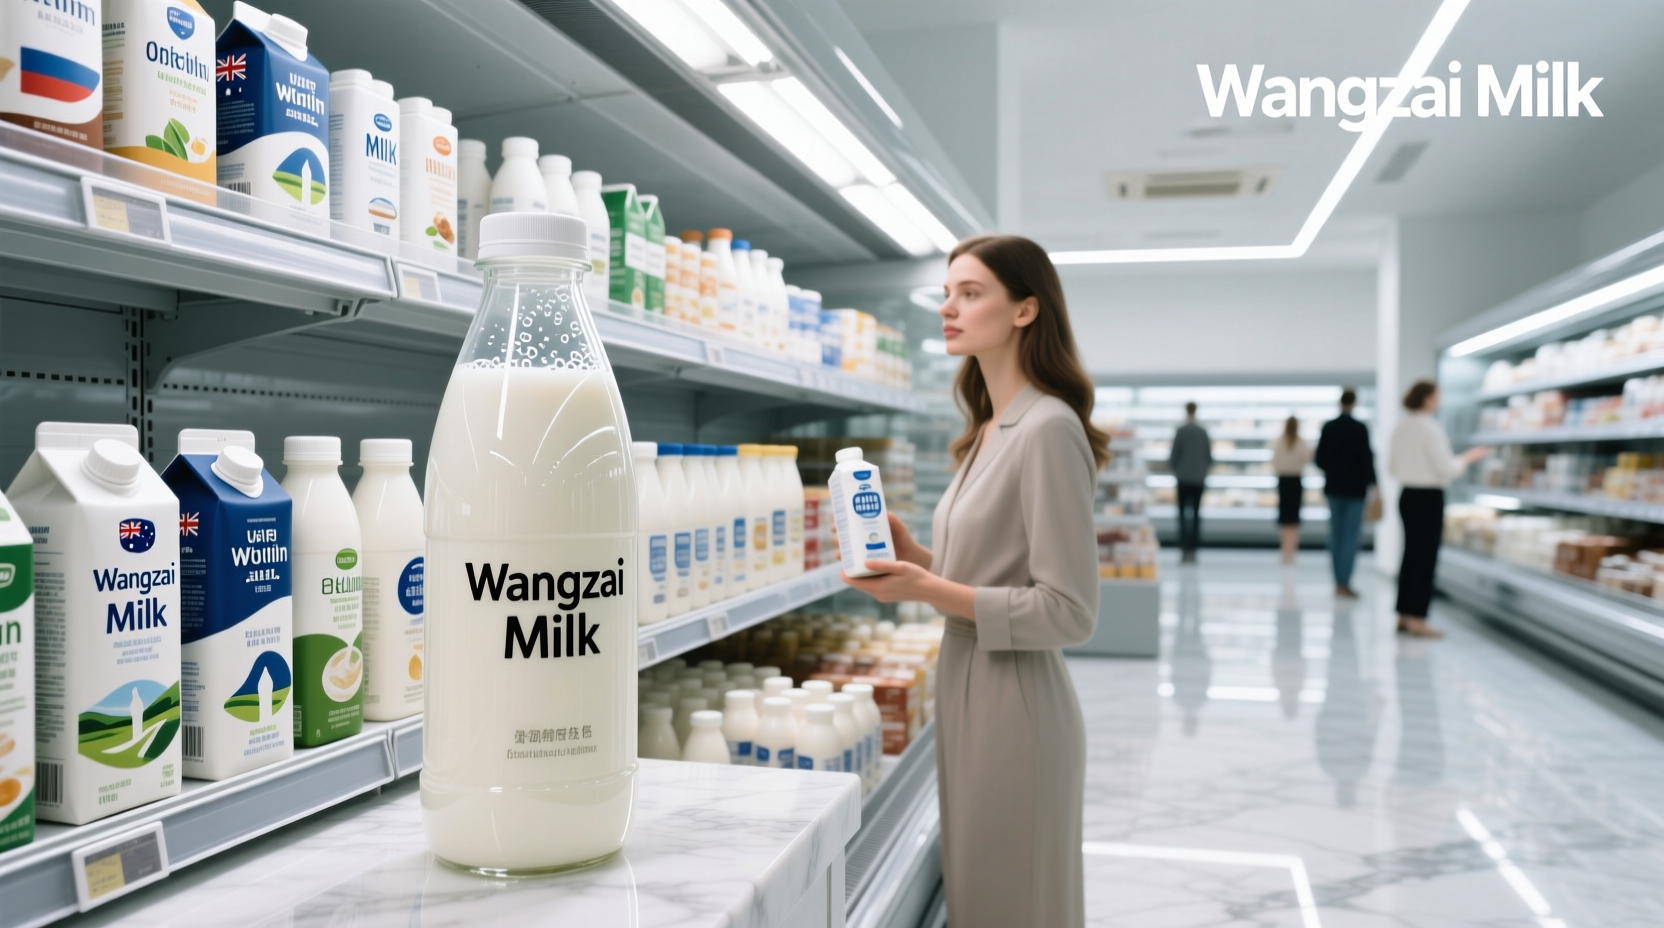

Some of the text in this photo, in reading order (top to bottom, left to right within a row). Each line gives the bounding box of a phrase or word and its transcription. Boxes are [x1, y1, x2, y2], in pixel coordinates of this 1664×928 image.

[93, 562, 176, 598] Wangzai
[465, 557, 625, 611] Wangzai
[106, 597, 168, 635] Milk
[504, 612, 601, 659] Milk
